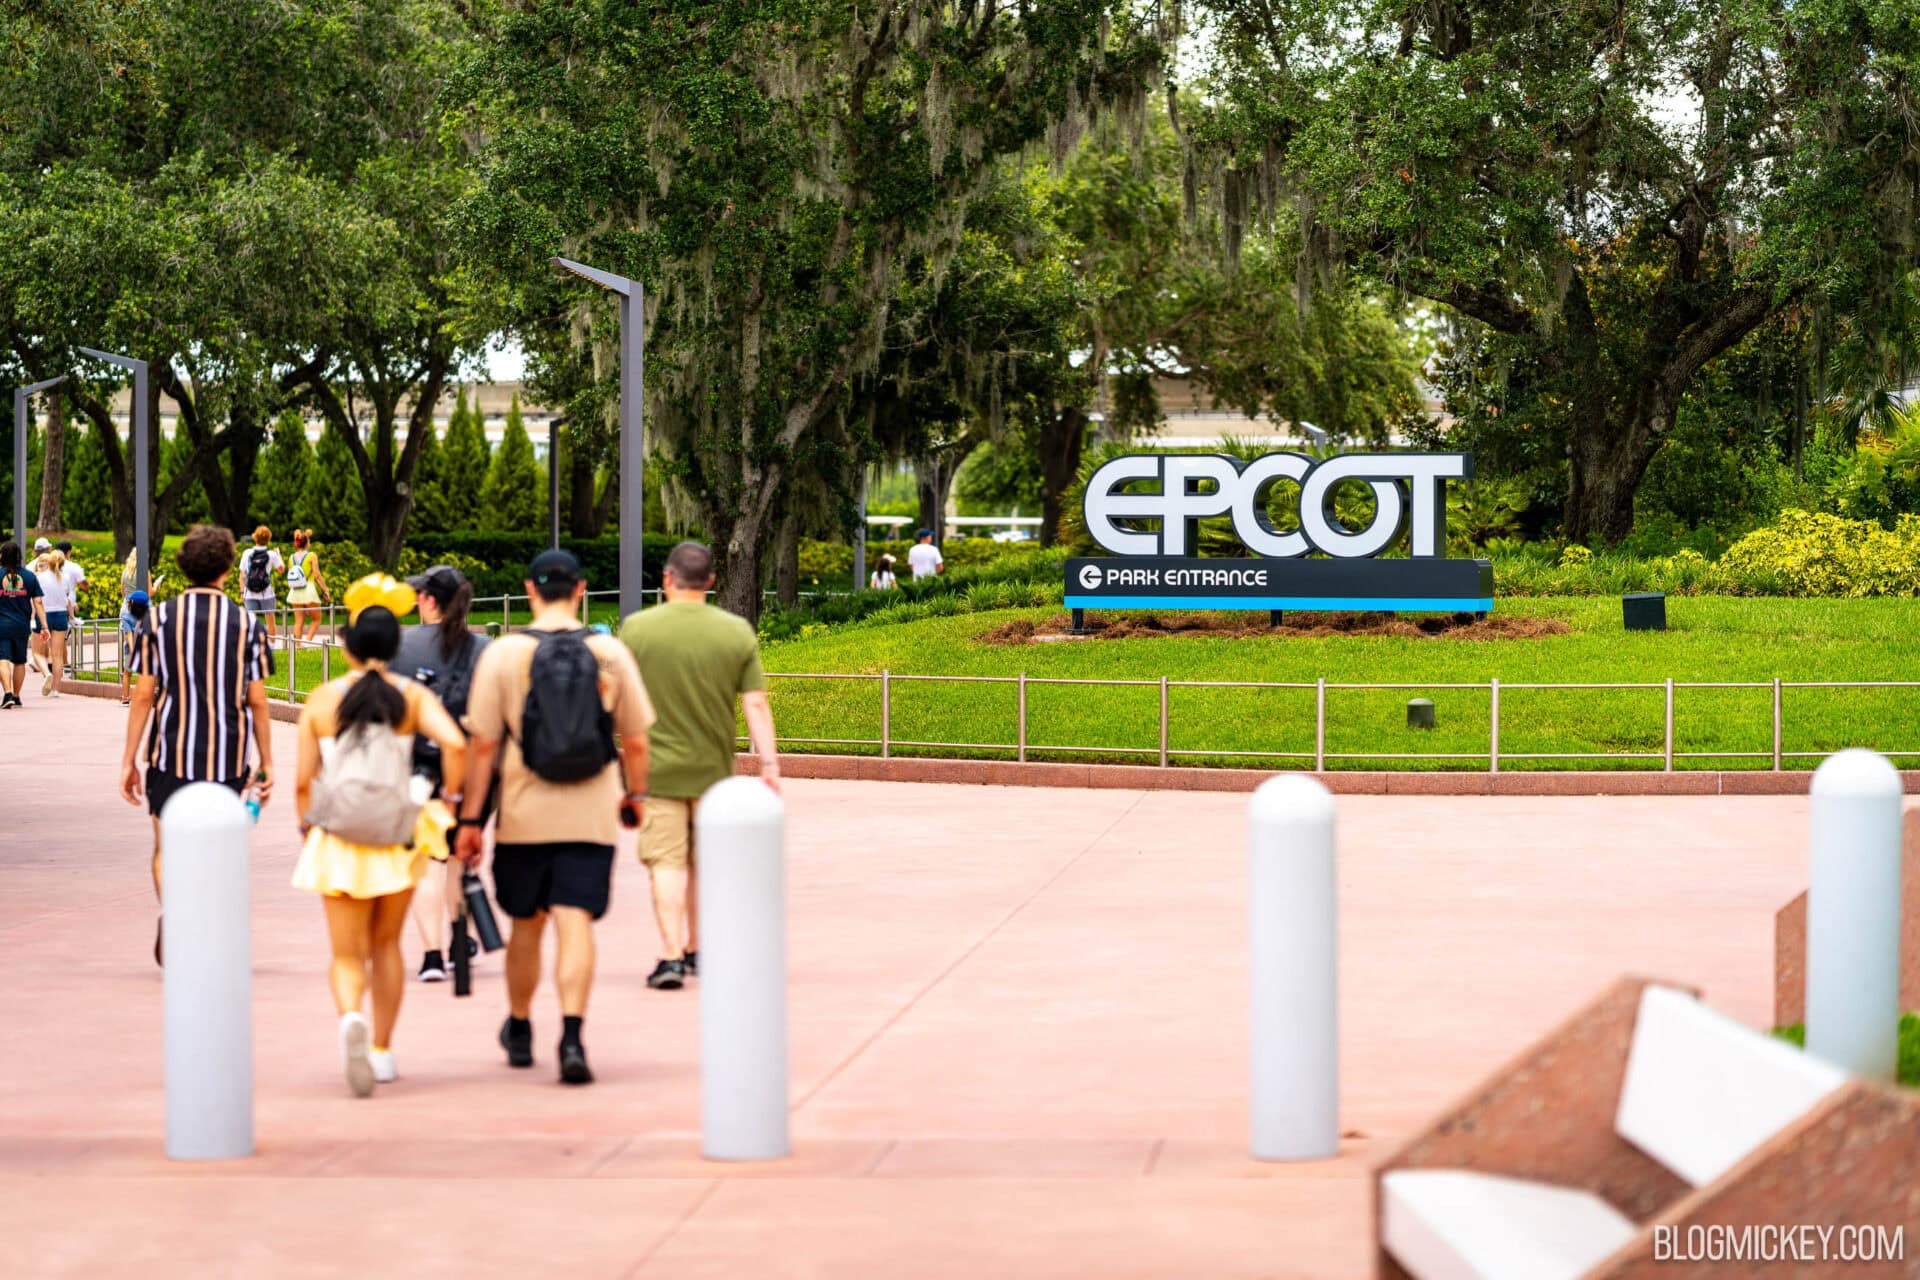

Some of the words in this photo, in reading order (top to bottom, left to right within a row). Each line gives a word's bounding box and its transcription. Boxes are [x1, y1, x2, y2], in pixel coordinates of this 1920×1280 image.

[1084, 453, 1466, 557] EPCOT
[1107, 569, 1160, 586] PARK
[1164, 569, 1268, 586] ENTRANCE
